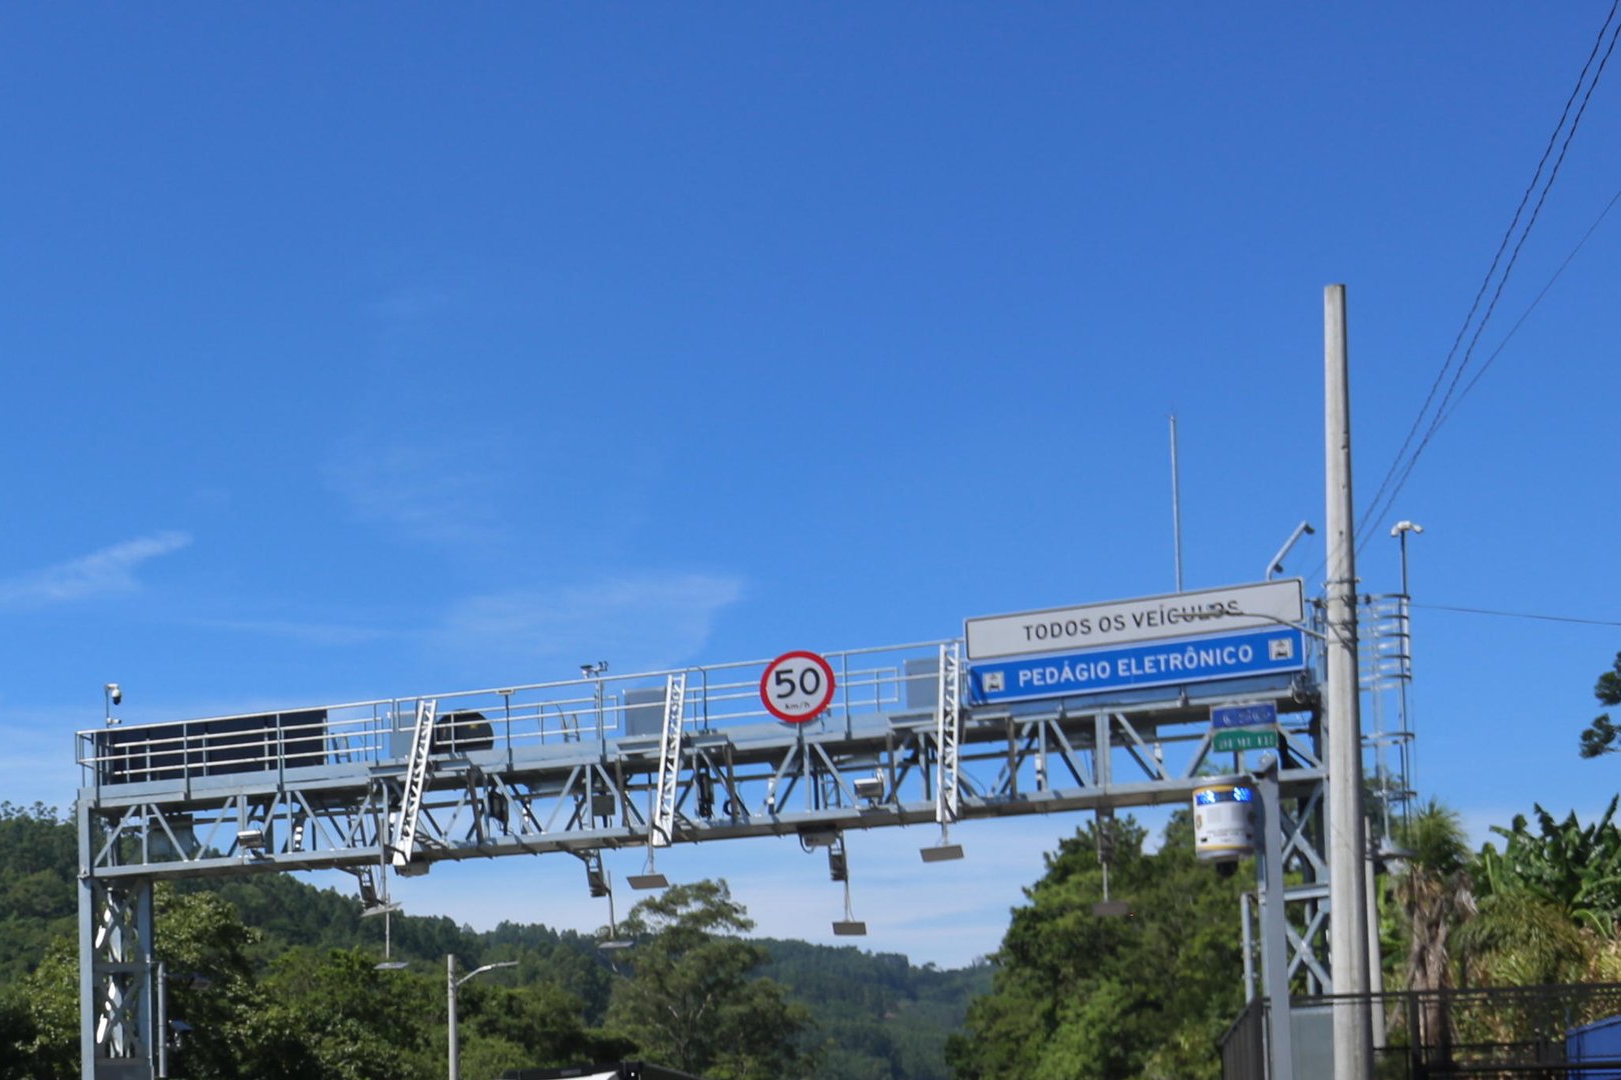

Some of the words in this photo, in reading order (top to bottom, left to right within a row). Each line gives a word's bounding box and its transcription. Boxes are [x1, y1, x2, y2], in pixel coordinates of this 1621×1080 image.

[1023, 619, 1092, 641] TODOS
[1099, 614, 1126, 633] OS
[1132, 600, 1240, 628] VEÍCULOS
[775, 667, 820, 699] 50
[1019, 660, 1111, 688] PEDÁGIO
[1117, 645, 1254, 677] ELETRÔNICO
[785, 701, 810, 710] km/h
